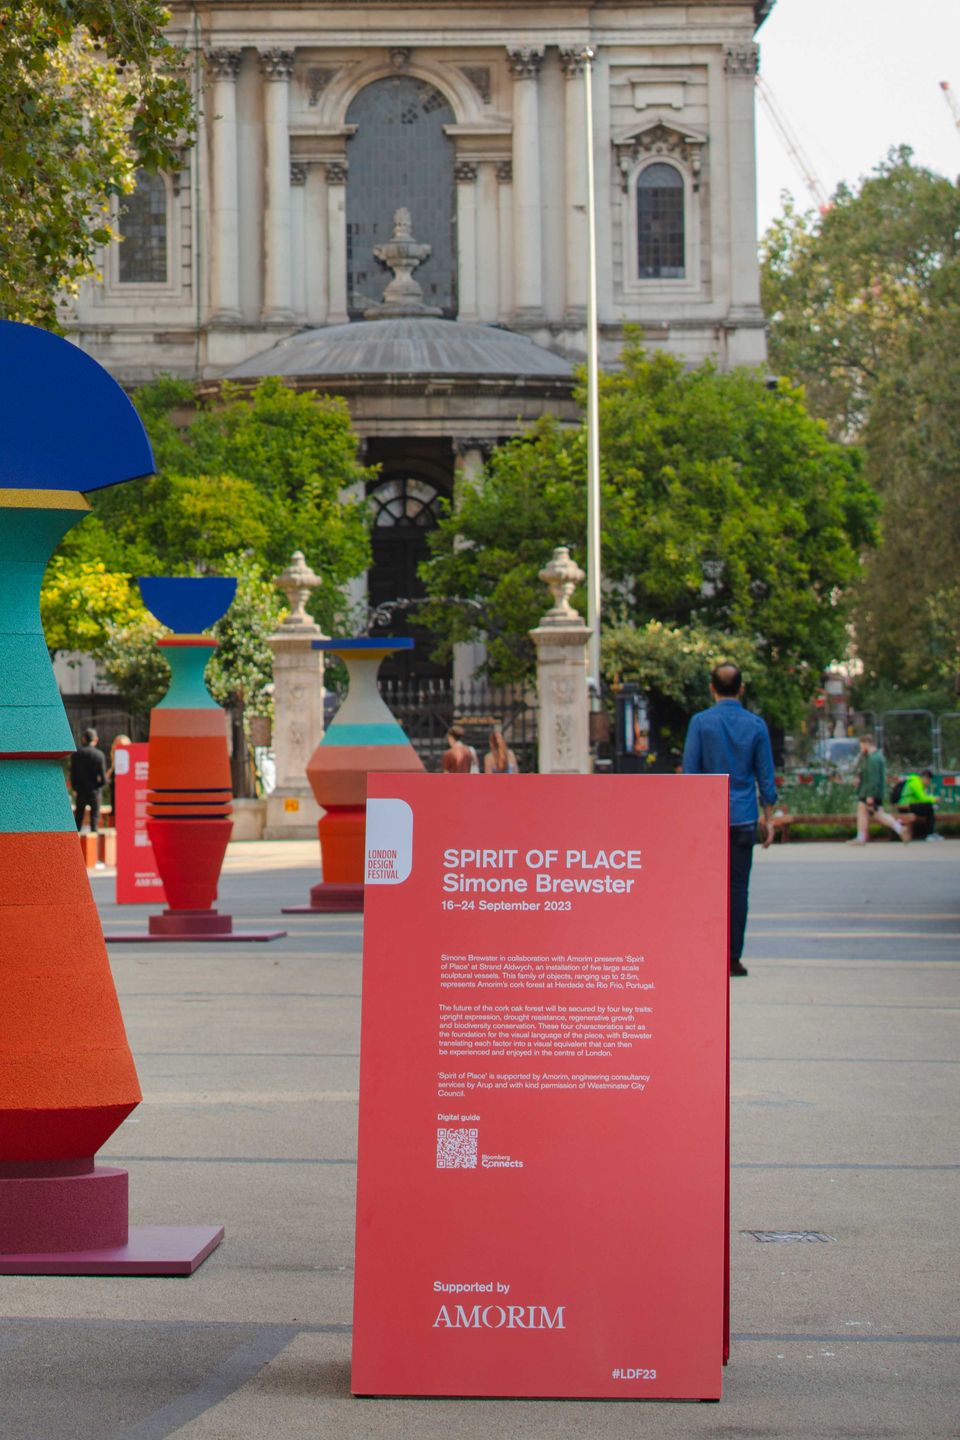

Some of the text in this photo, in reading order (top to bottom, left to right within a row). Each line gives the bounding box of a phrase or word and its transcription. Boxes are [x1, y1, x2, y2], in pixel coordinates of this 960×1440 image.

[368, 850, 397, 859] LONDON
[443, 848, 642, 870] SPIRIT OF PLACE
[368, 860, 394, 869] DESIGN
[368, 870, 399, 879] FESTIVAL
[442, 873, 635, 894] Simone Brewster
[478, 900, 540, 912] September
[544, 900, 572, 911] 2023
[460, 1114, 480, 1122] guide
[481, 1160, 523, 1169] Connects
[433, 1281, 510, 1294] Supported by
[432, 1305, 566, 1329] AMORIM
[612, 1368, 657, 1380] #LDF23
